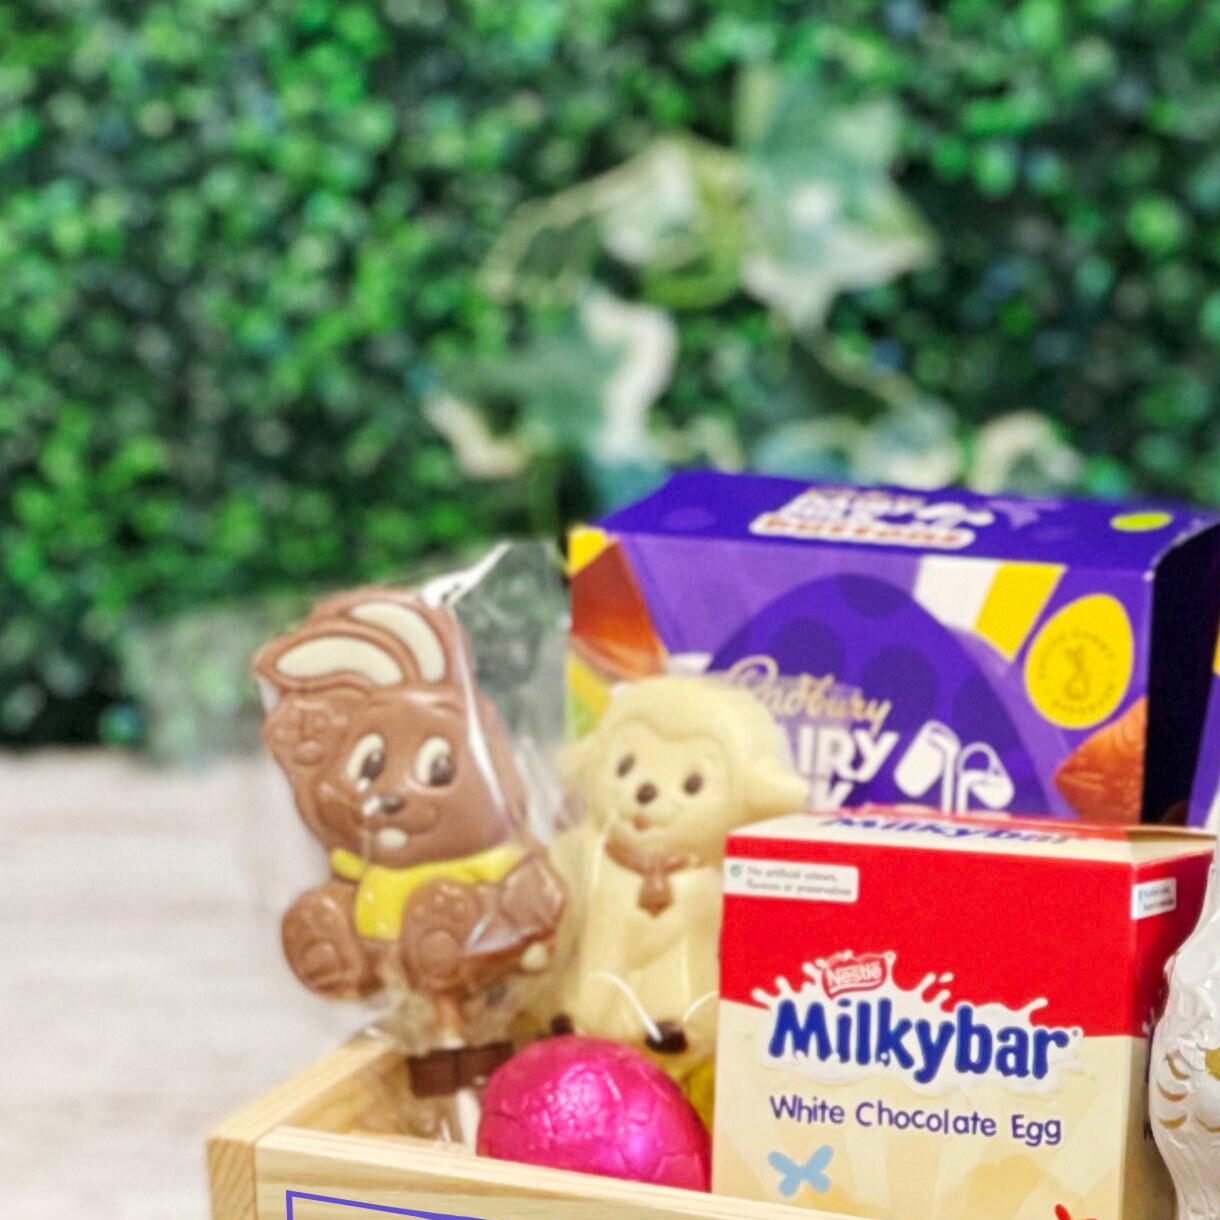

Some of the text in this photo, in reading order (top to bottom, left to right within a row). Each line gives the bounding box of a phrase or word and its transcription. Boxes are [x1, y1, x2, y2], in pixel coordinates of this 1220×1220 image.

[799, 725, 900, 783] IRY
[768, 997, 1070, 1084] Milkybar
[769, 1095, 1062, 1147] White Chocolate Egg
